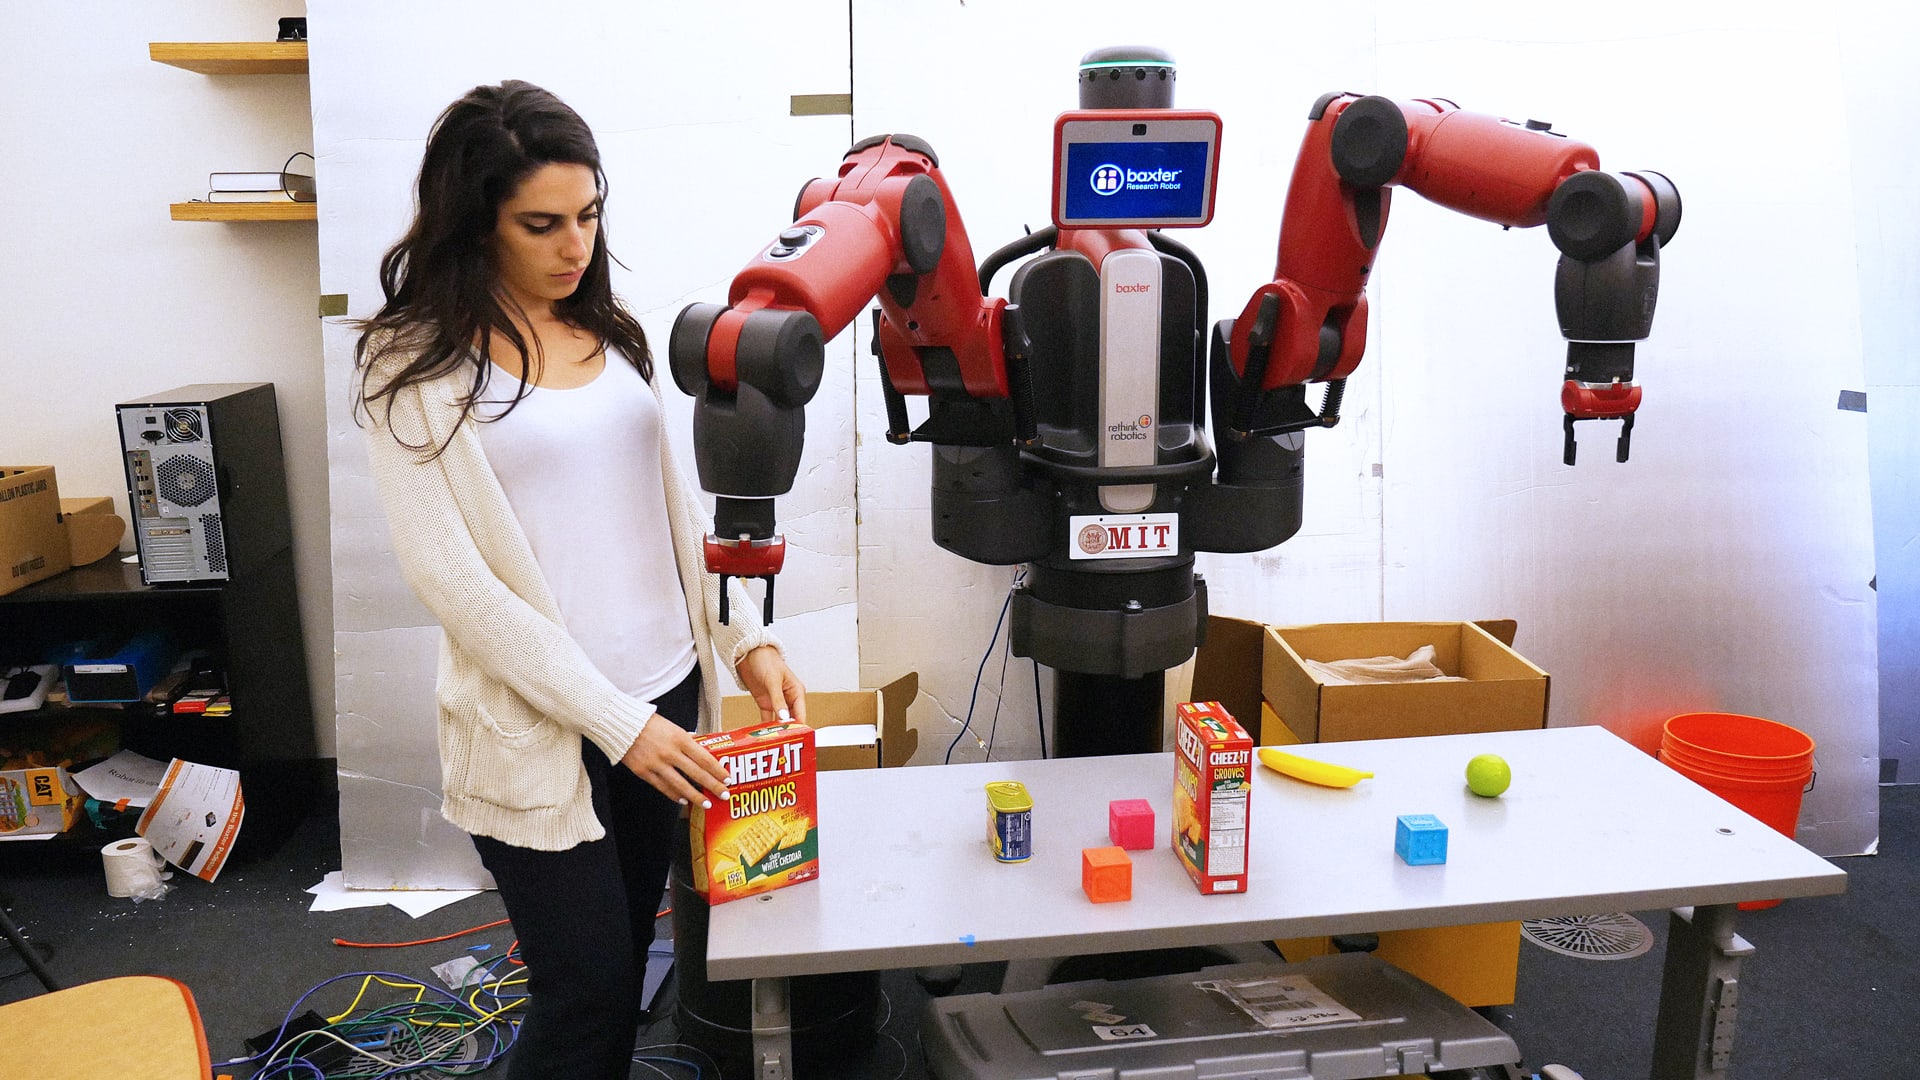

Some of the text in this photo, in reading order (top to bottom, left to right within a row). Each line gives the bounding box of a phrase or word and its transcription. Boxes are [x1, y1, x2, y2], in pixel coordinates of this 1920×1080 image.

[1126, 168, 1179, 182] baxter
[1115, 283, 1151, 293] baxter
[1108, 421, 1138, 432] rethink
[1110, 431, 1147, 441] robotics
[15, 482, 34, 497] PLASTIC
[33, 775, 52, 797] CAT
[221, 824, 235, 847] Baxter
[761, 850, 802, 873] WHITE CHEDDAR
[1109, 1026, 1147, 1037] 64
